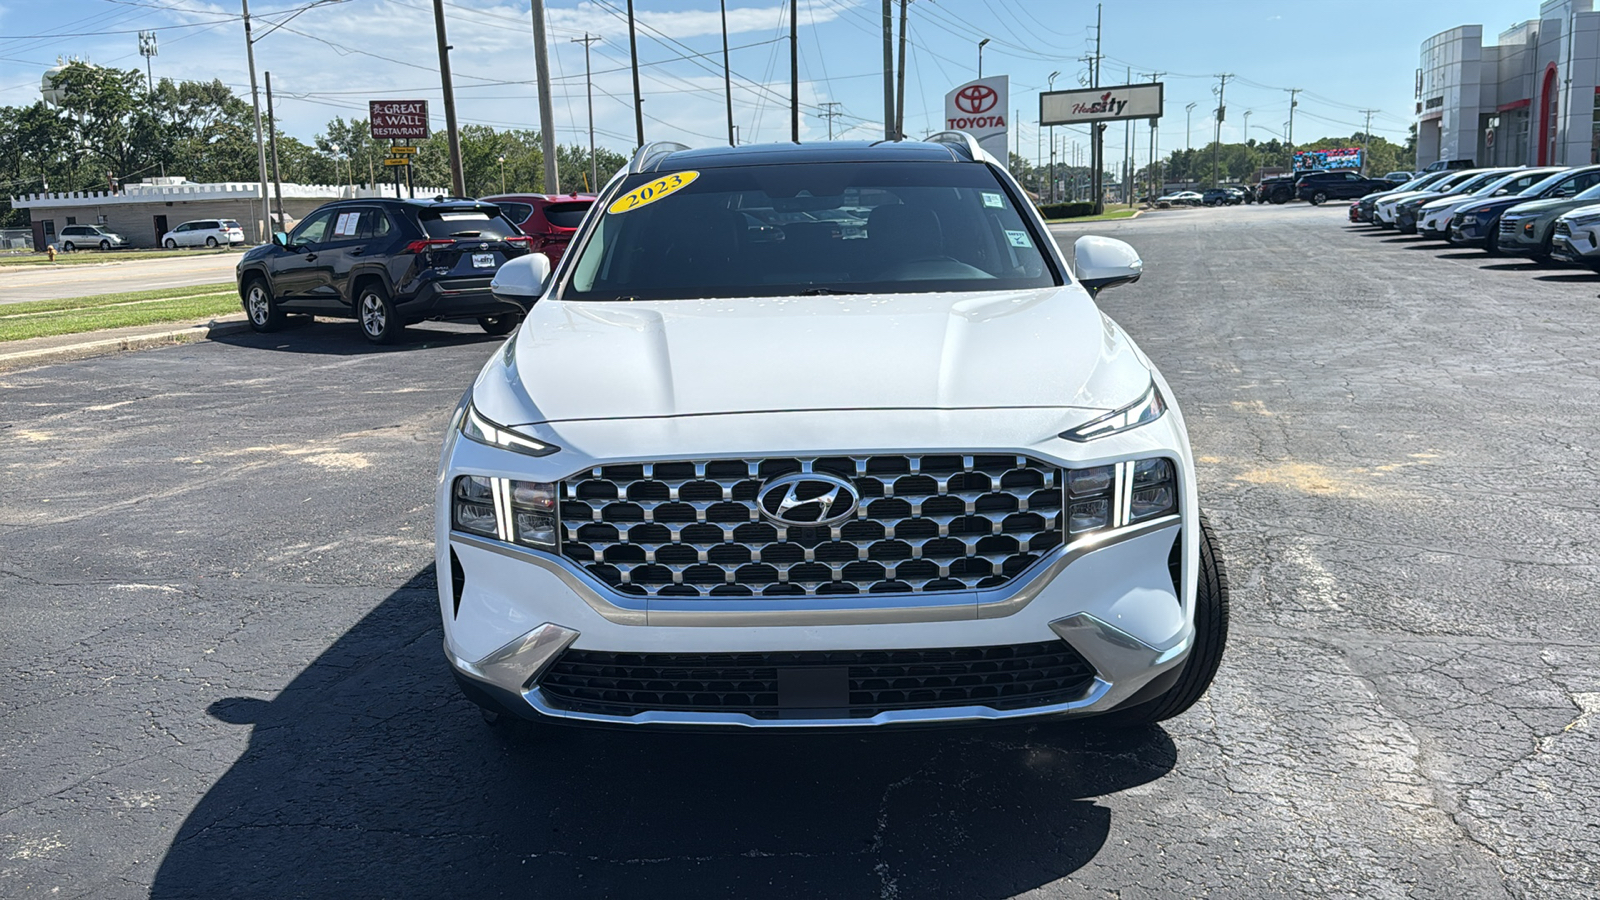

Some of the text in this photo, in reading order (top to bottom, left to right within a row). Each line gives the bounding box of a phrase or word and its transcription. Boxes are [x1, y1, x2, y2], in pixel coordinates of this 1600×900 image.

[384, 104, 422, 114] GREAT
[385, 116, 421, 125] WALL
[948, 116, 1005, 129] TOYOTA
[373, 127, 424, 136] RESTAURANT
[625, 175, 683, 208] 2023
